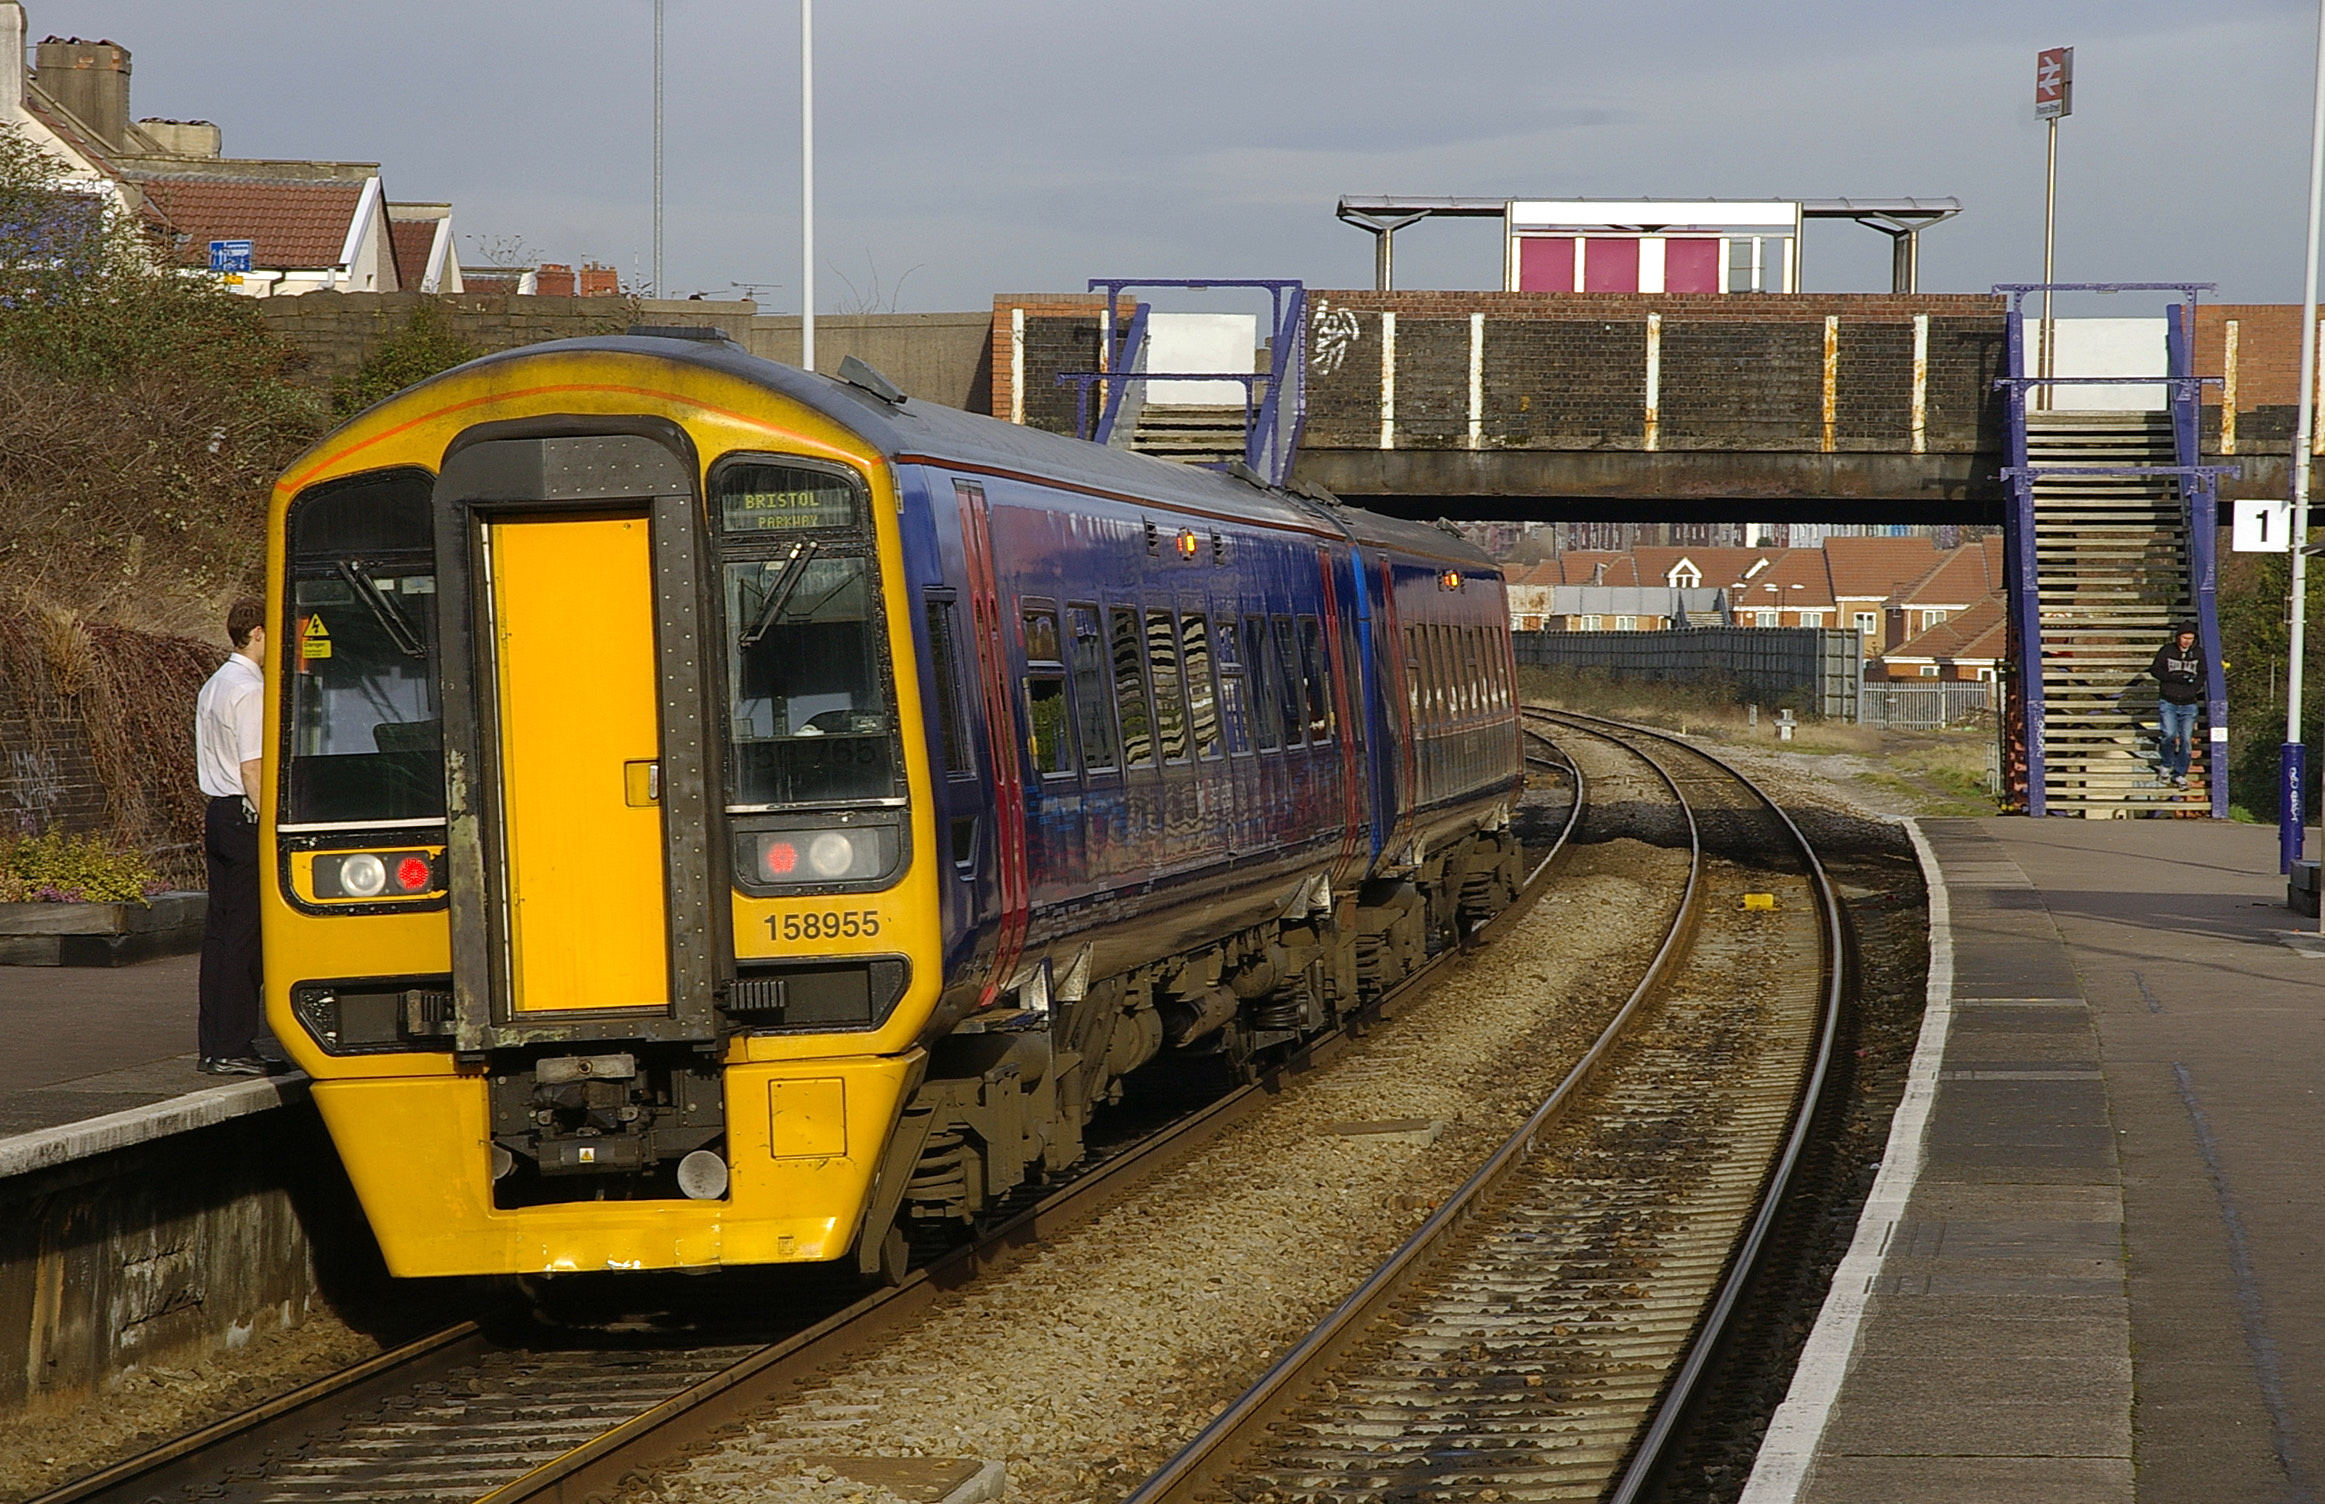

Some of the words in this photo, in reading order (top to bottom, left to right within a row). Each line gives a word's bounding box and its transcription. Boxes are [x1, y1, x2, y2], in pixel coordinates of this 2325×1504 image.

[744, 492, 820, 510] BRISTOL
[758, 514, 818, 529] PARKWAY
[2256, 509, 2269, 542] 1
[763, 910, 880, 941] 158955
